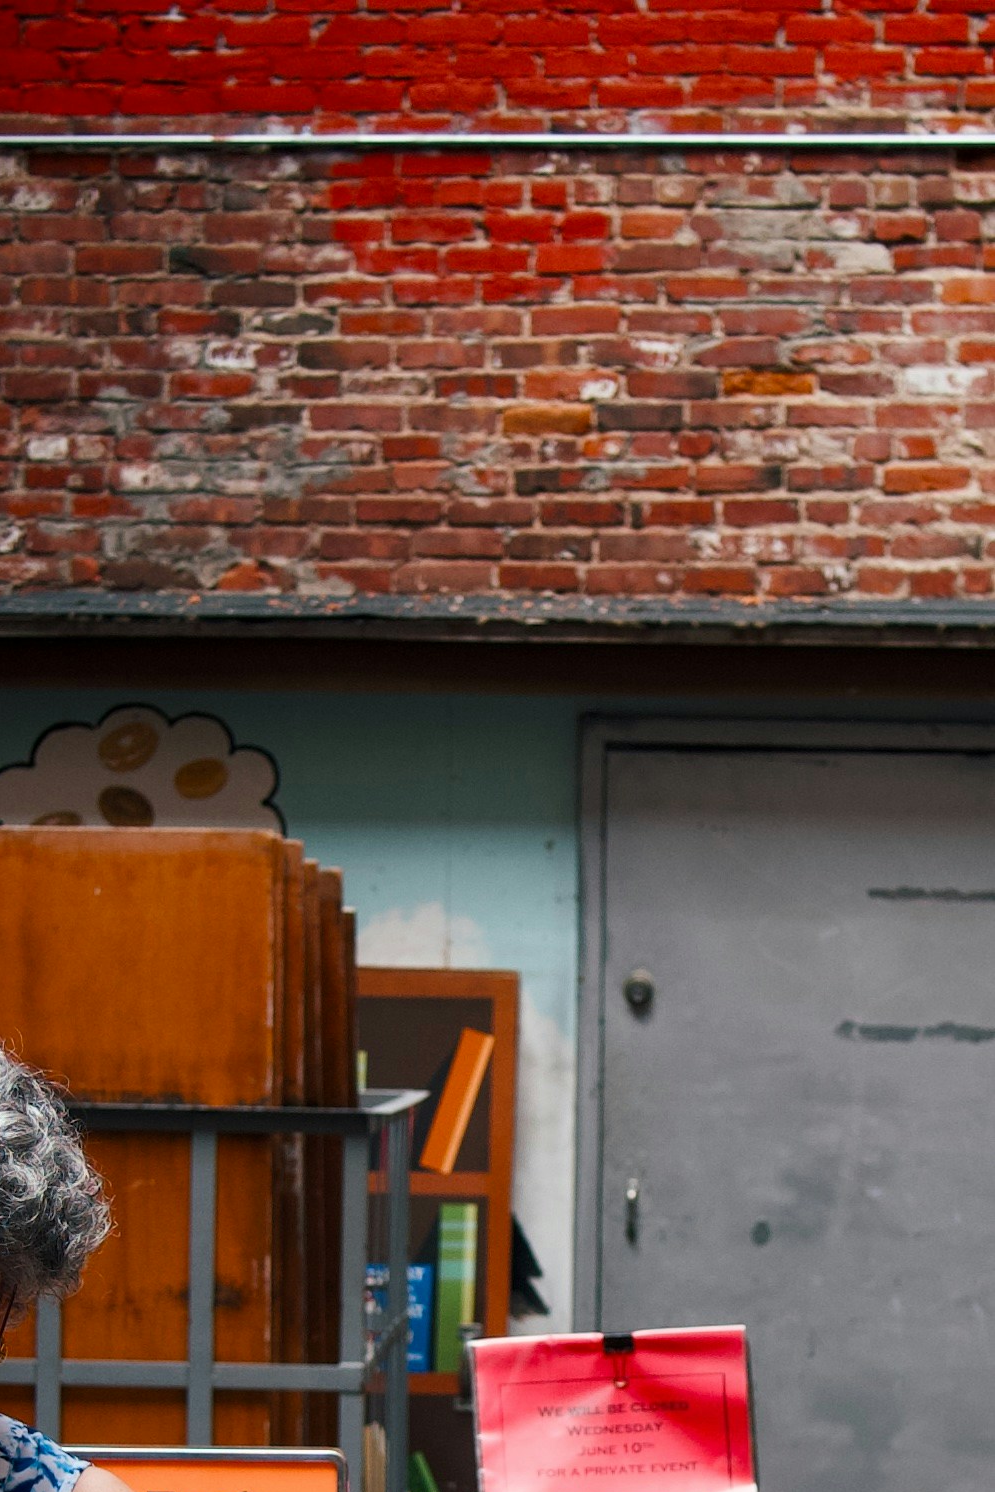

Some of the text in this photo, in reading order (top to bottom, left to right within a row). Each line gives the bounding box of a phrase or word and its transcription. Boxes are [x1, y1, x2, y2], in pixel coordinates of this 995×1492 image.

[578, 1444, 617, 1457] JUNE
[537, 1461, 699, 1479] FOR A PRIVATE EVENT
